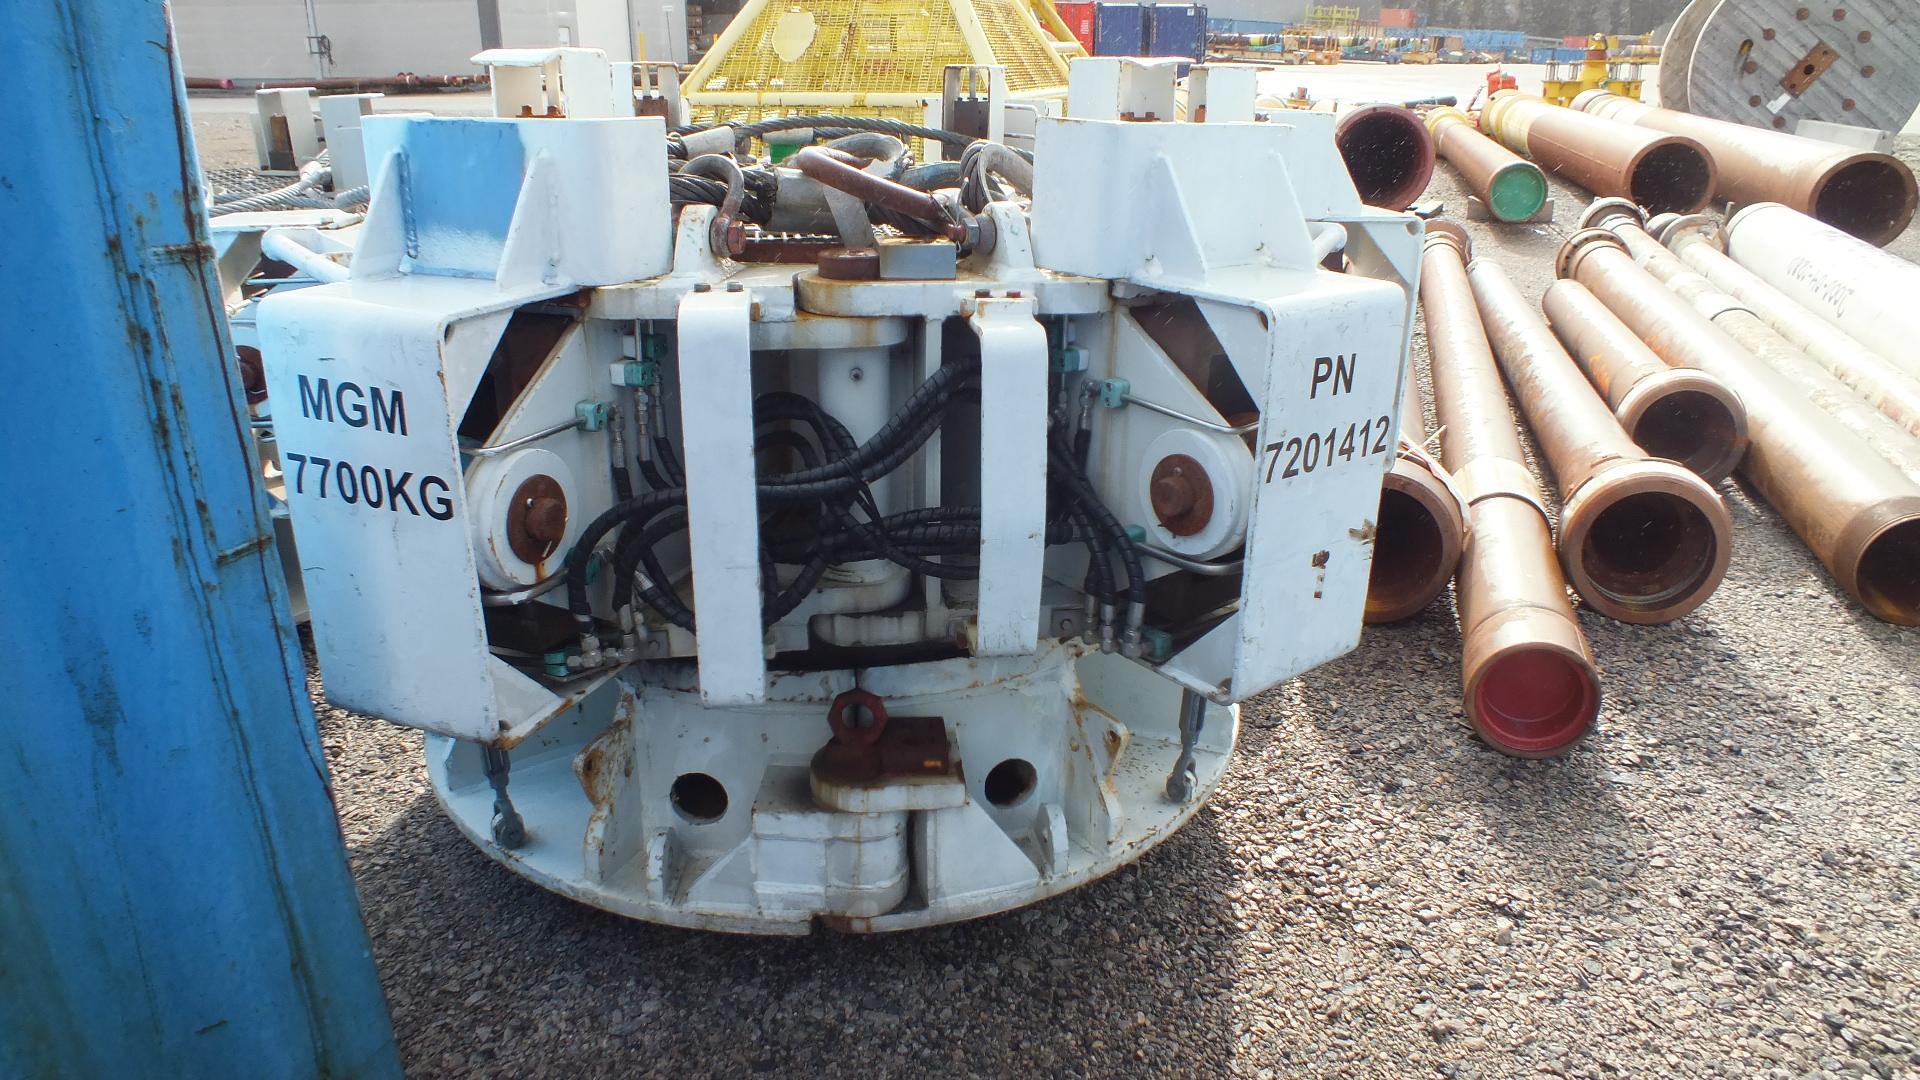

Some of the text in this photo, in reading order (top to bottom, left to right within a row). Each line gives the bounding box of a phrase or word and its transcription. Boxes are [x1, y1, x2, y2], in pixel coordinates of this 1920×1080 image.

[298, 374, 408, 436] MGM
[1310, 353, 1356, 399] PN
[1265, 415, 1390, 484] 7201412
[287, 452, 454, 521] 7700KG
